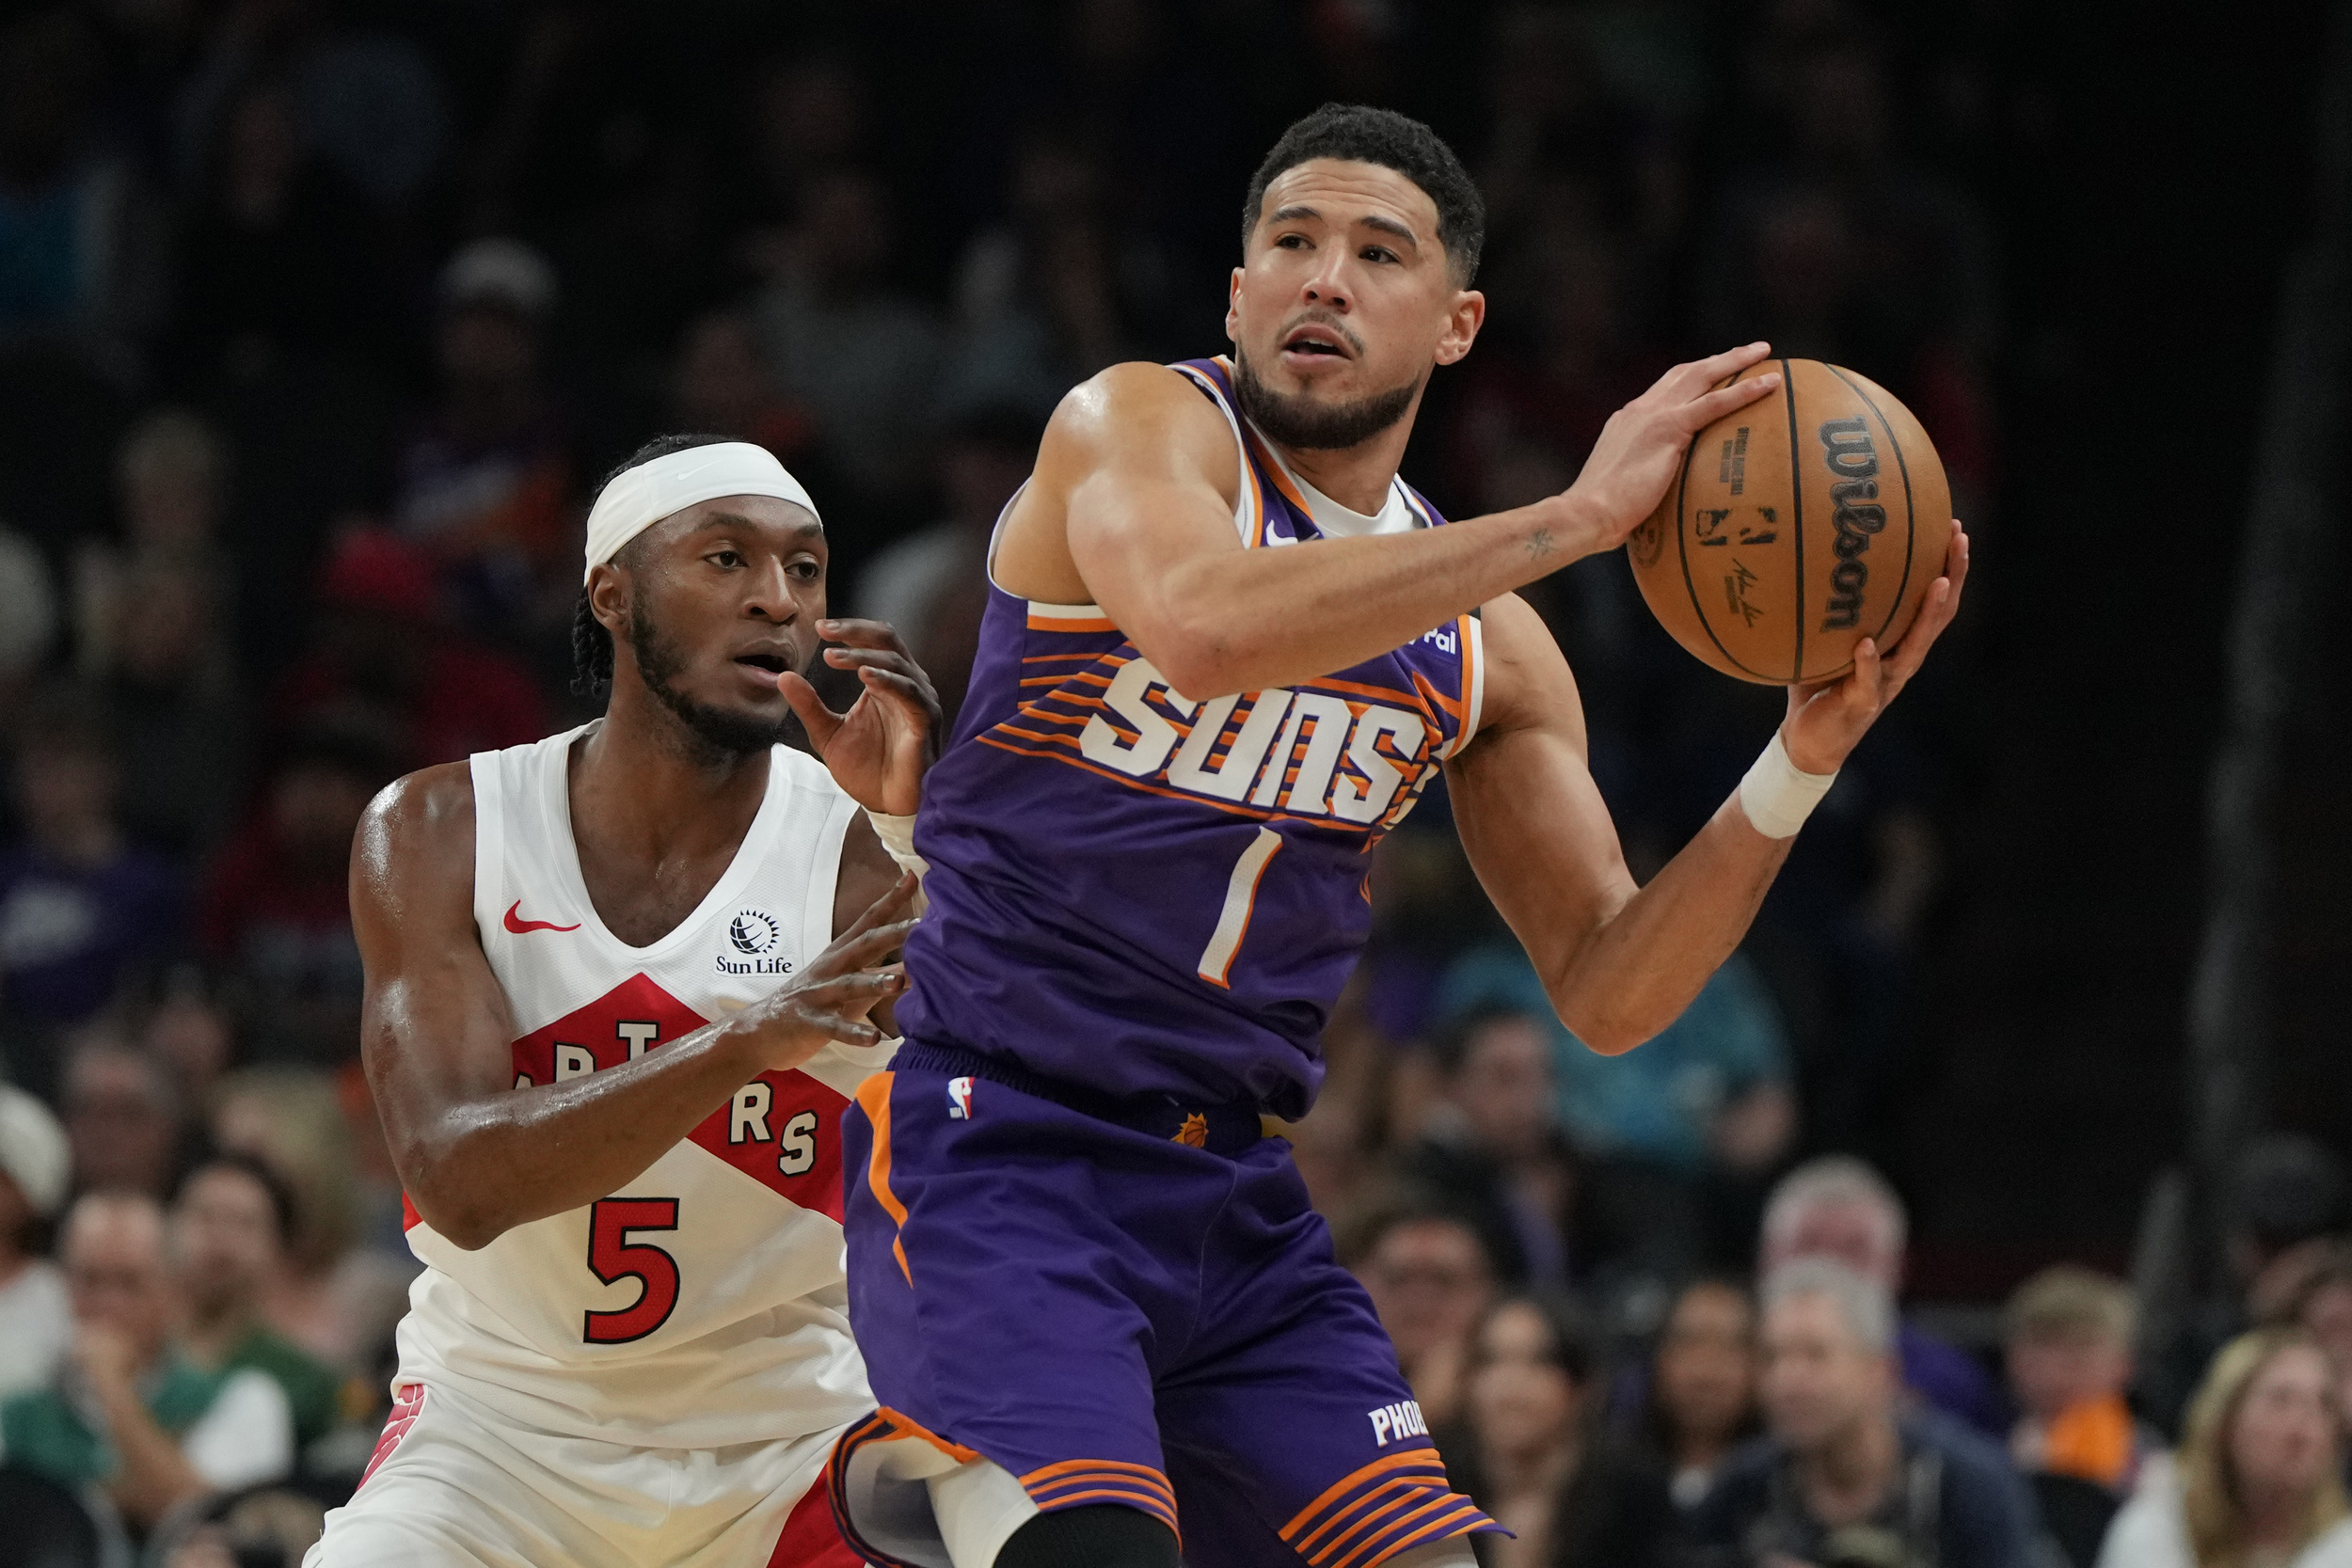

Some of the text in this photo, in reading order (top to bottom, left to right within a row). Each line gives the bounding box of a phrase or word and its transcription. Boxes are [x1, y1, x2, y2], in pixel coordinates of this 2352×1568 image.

[1820, 416, 1885, 631] Wilson
[1079, 657, 1425, 823] SUNS
[716, 956, 793, 974] Sun Life
[1198, 826, 1282, 989] 1
[583, 1197, 680, 1344] 5
